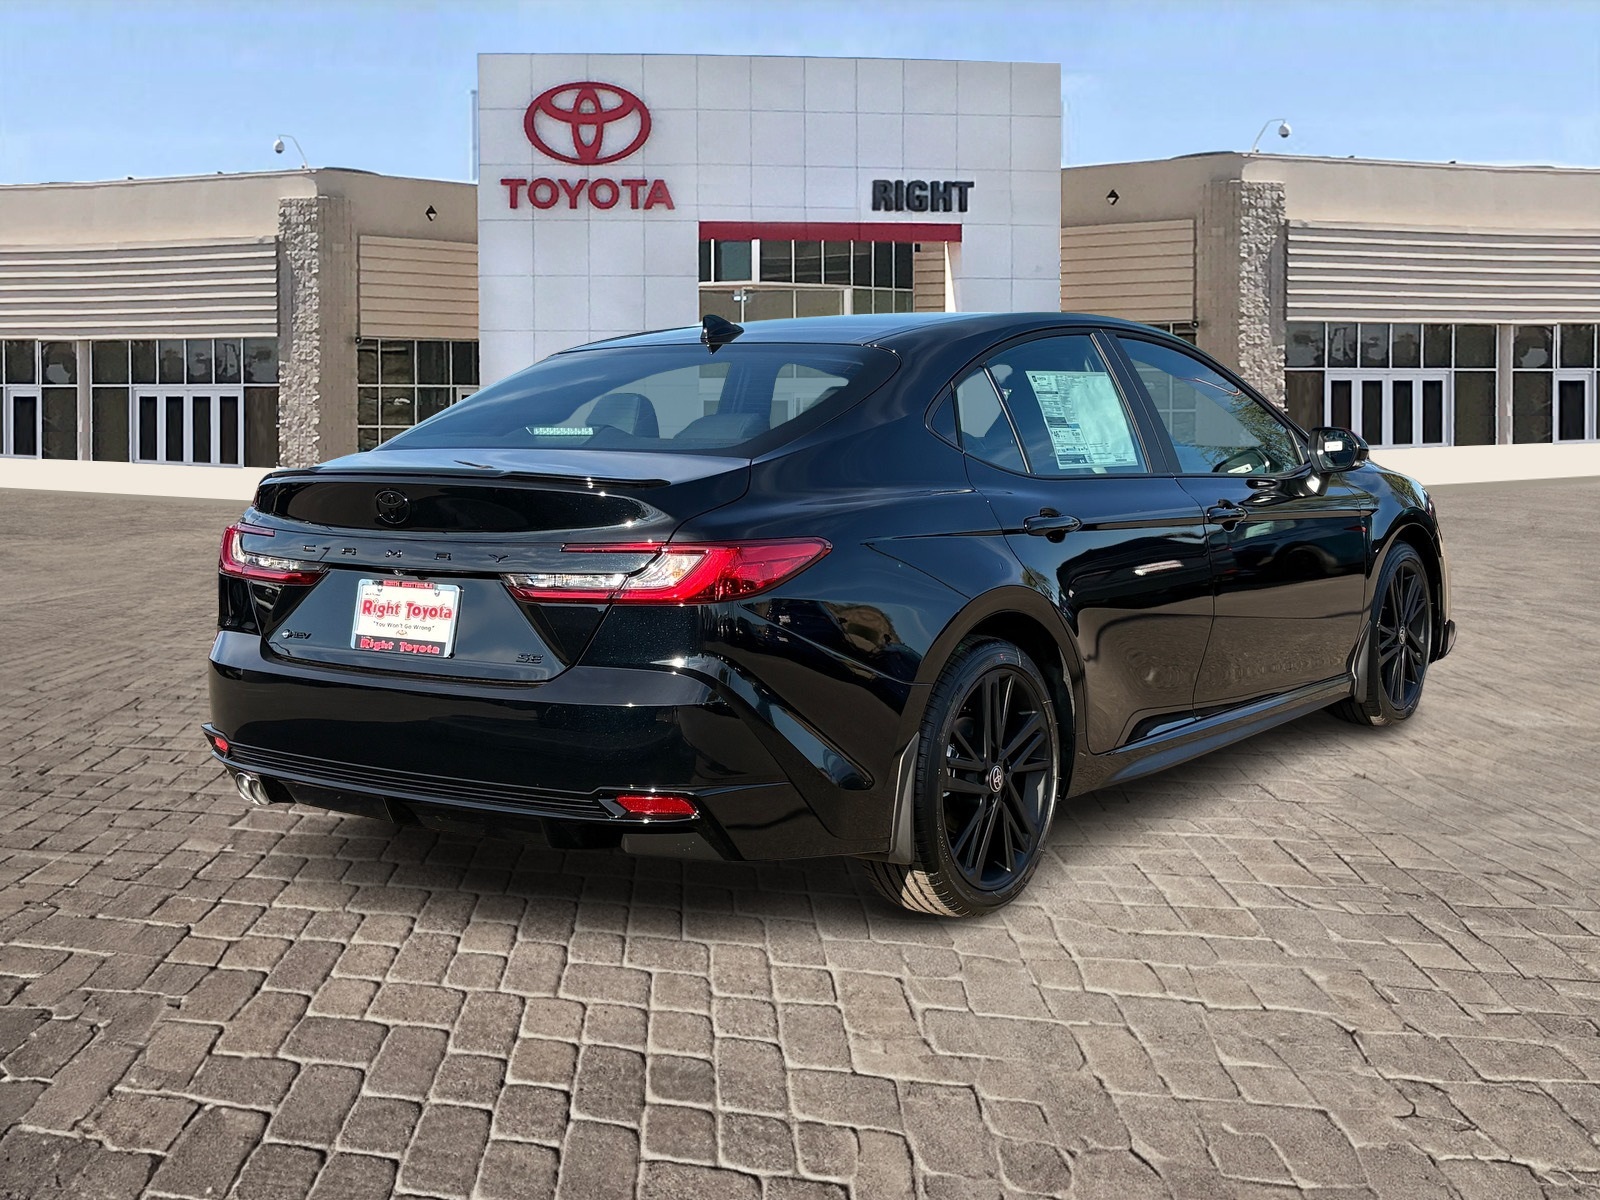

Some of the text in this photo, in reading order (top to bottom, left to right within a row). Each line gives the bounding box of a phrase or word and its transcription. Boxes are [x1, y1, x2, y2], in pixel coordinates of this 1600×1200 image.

[501, 178, 675, 210] TOYOTA
[871, 179, 975, 213] RIGHT
[303, 544, 510, 564] CAMRY
[361, 599, 453, 621] Right Toyota
[360, 638, 440, 654] Right Toyota
